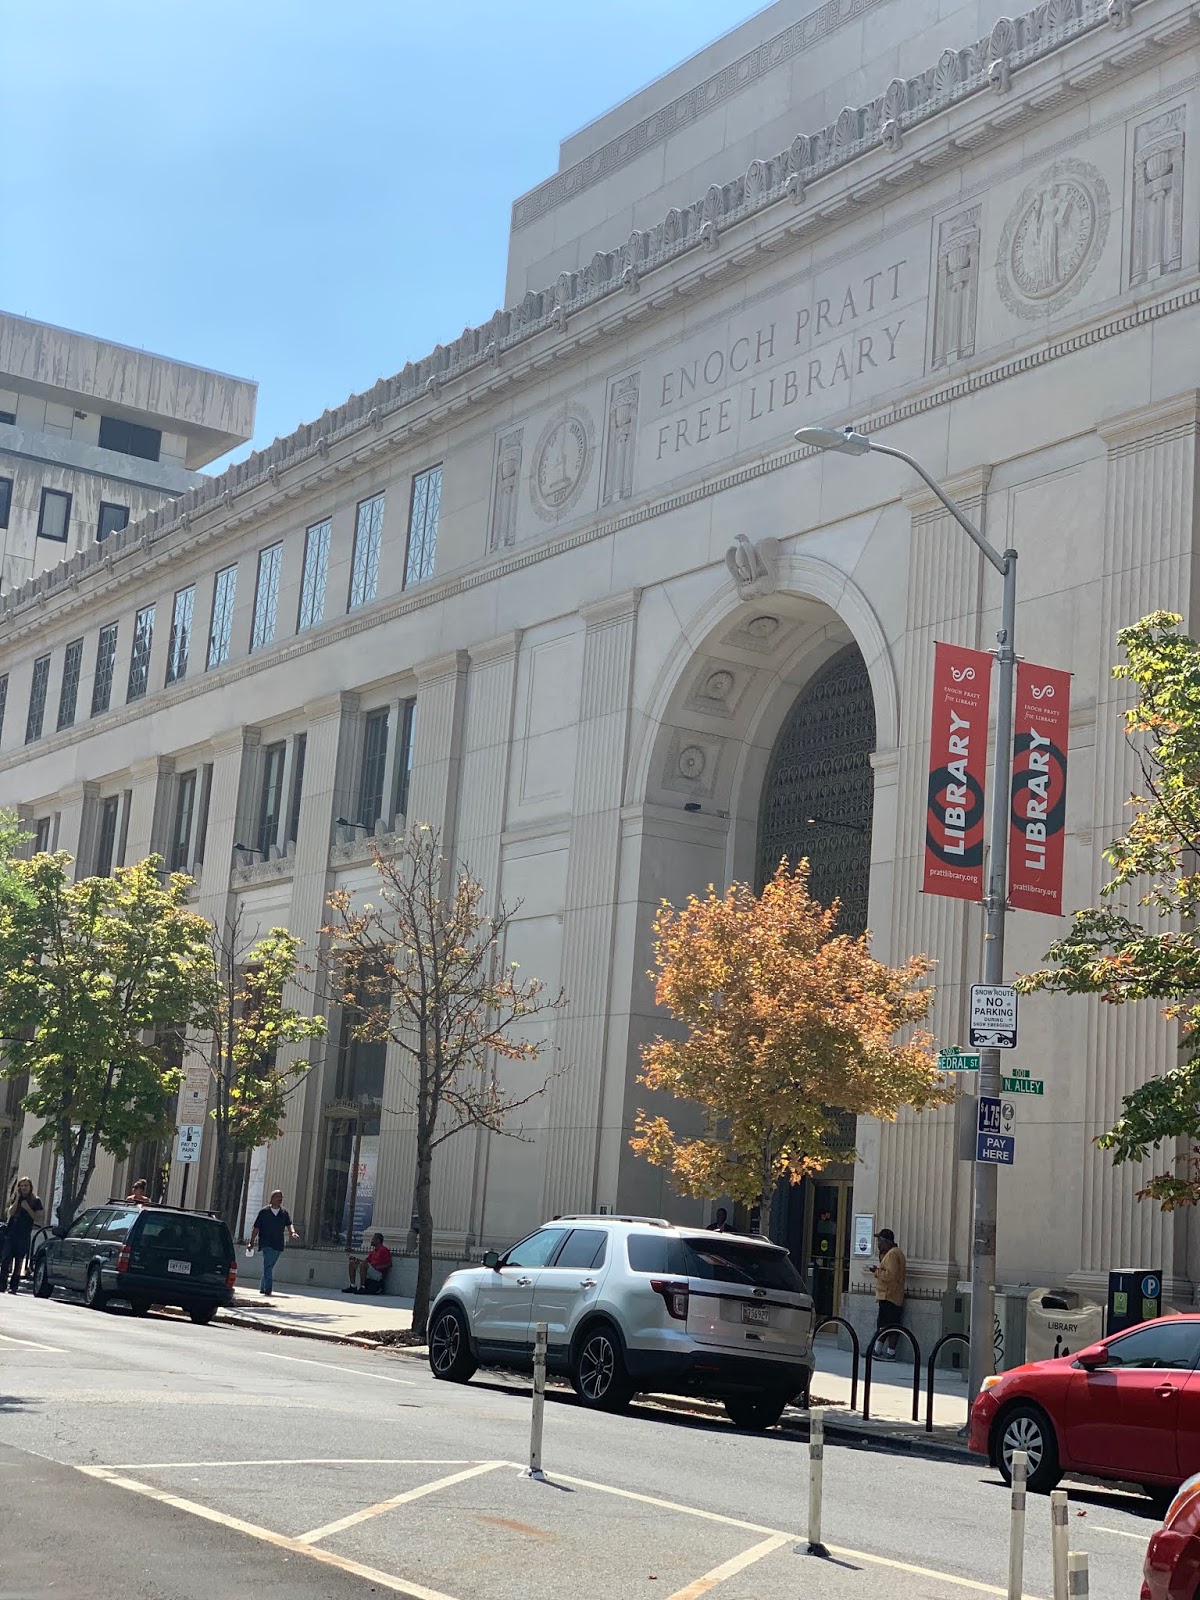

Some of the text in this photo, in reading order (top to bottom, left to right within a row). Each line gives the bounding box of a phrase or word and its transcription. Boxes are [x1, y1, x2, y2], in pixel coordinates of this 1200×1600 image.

[660, 260, 907, 407] ENOCH PRATT
[656, 320, 905, 460] FREE LIBRARY
[943, 686, 981, 699] ENOCH PRATT
[955, 697, 978, 707] LIBRARY
[1024, 704, 1060, 716] ENOCH PRATT
[1035, 715, 1058, 724] LIBRARY
[944, 709, 971, 856] LIBRARY
[1025, 726, 1051, 870] LIBRARY
[929, 867, 978, 883] prattlibrary.org
[1013, 883, 1057, 899] prattlibrary.org
[993, 989, 1015, 997] ROUTE
[986, 997, 1003, 1007] NO
[974, 1007, 1014, 1017] PARKING
[970, 1059, 979, 1067] ST.
[1005, 1079, 1041, 1093] N. ALLEY
[1005, 1104, 1012, 1115] 2
[987, 1137, 1007, 1149] PAY
[982, 1149, 1010, 1161] HERE
[1047, 1321, 1079, 1333] LIBRARY
